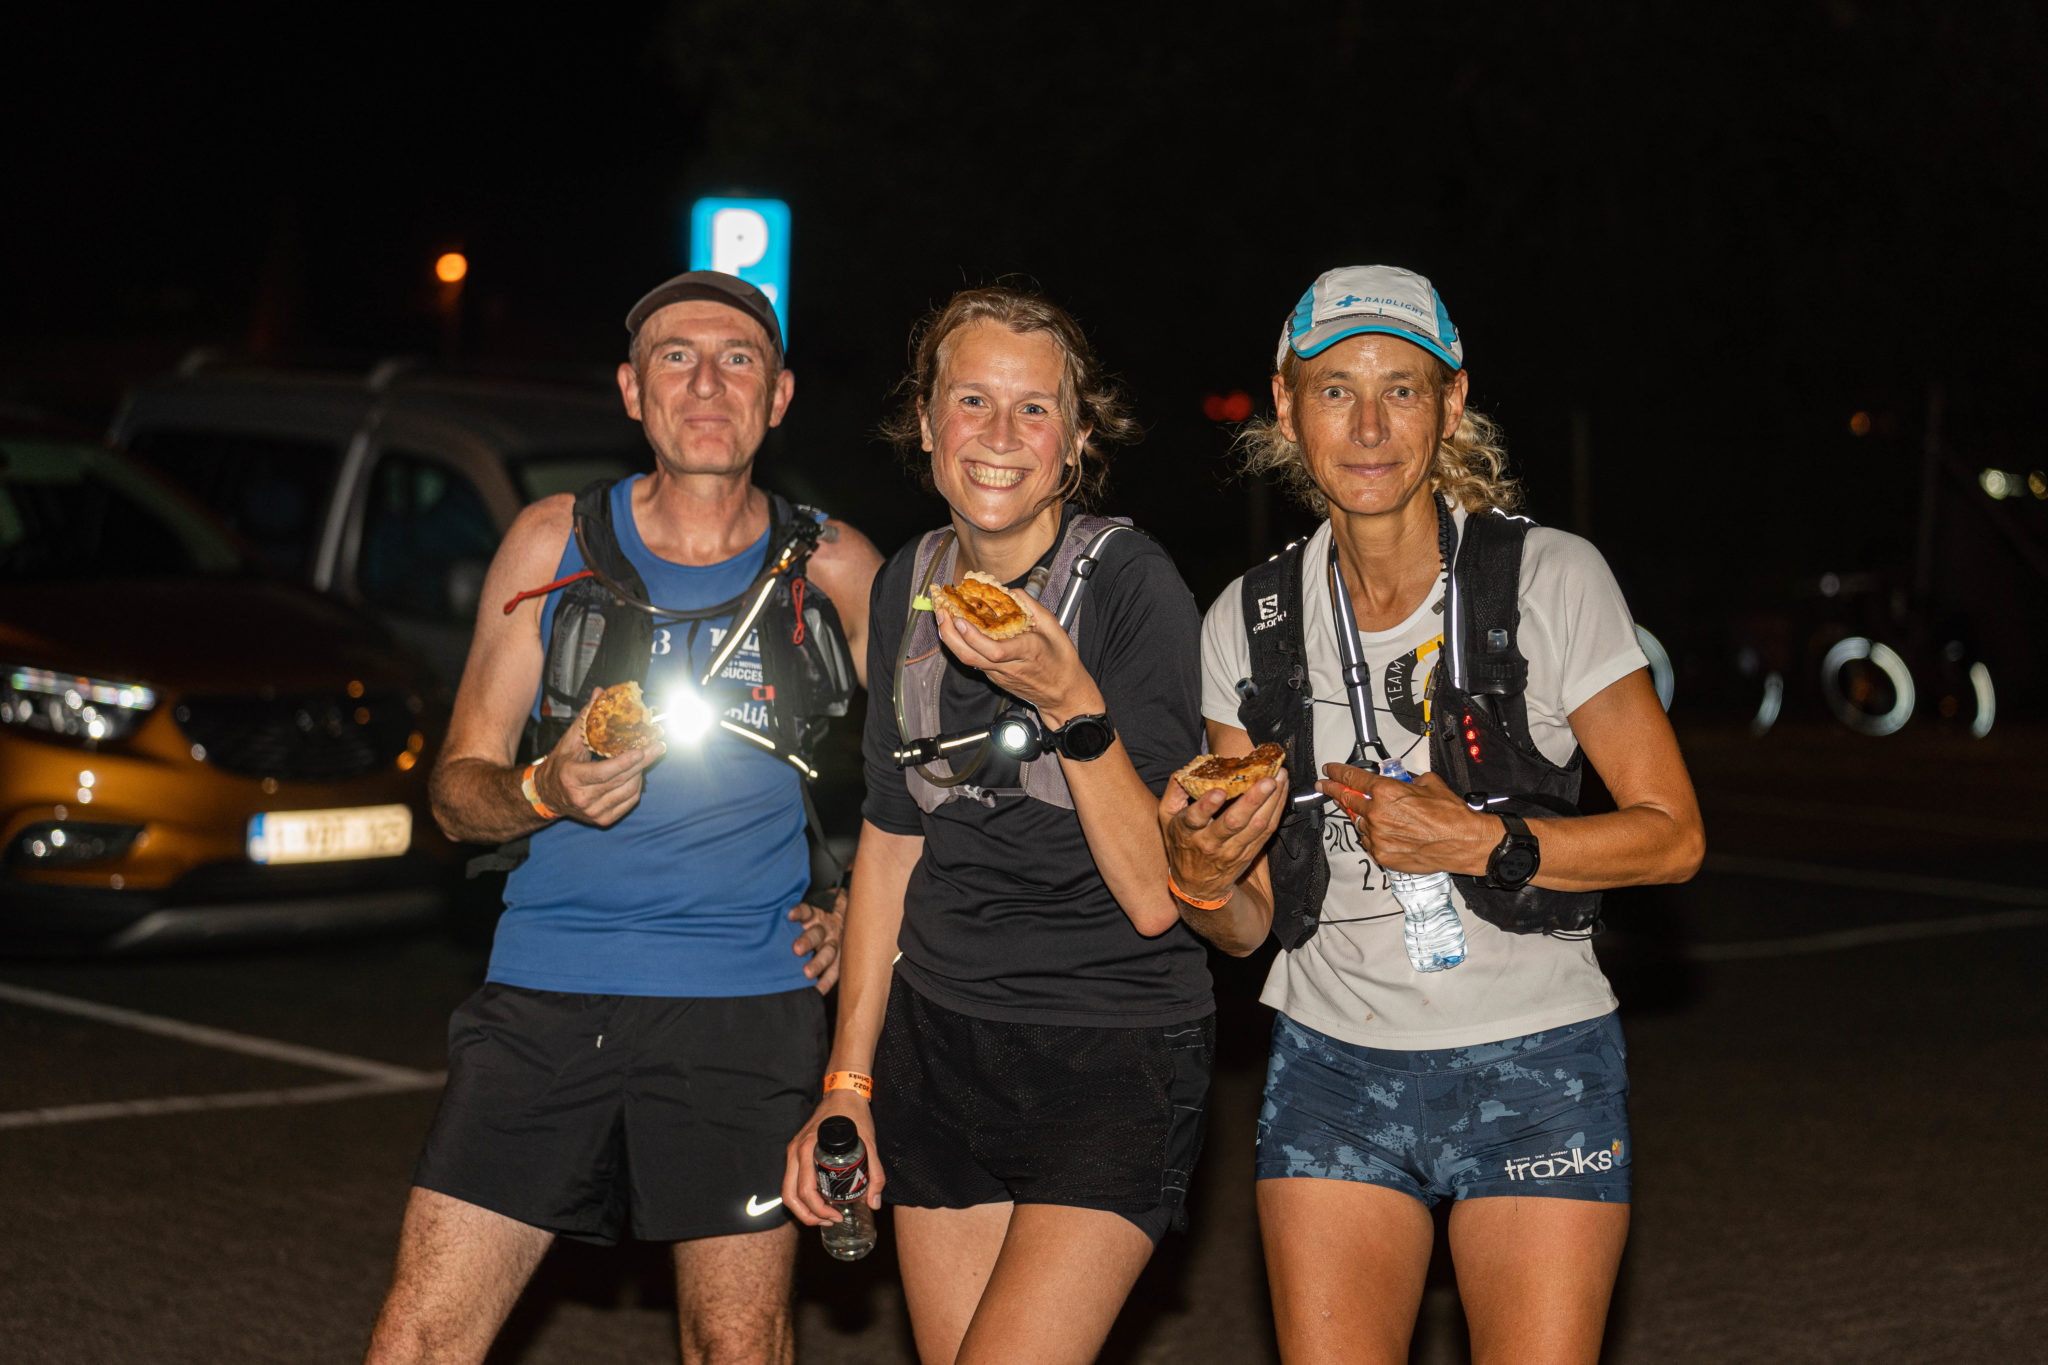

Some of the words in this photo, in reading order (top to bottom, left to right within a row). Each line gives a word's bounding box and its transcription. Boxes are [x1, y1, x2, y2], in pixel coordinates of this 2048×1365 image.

[712, 208, 769, 277] P
[1364, 296, 1425, 317] RAIDLIGHT
[1387, 660, 1406, 703] TEAM
[853, 1081, 870, 1093] 2022
